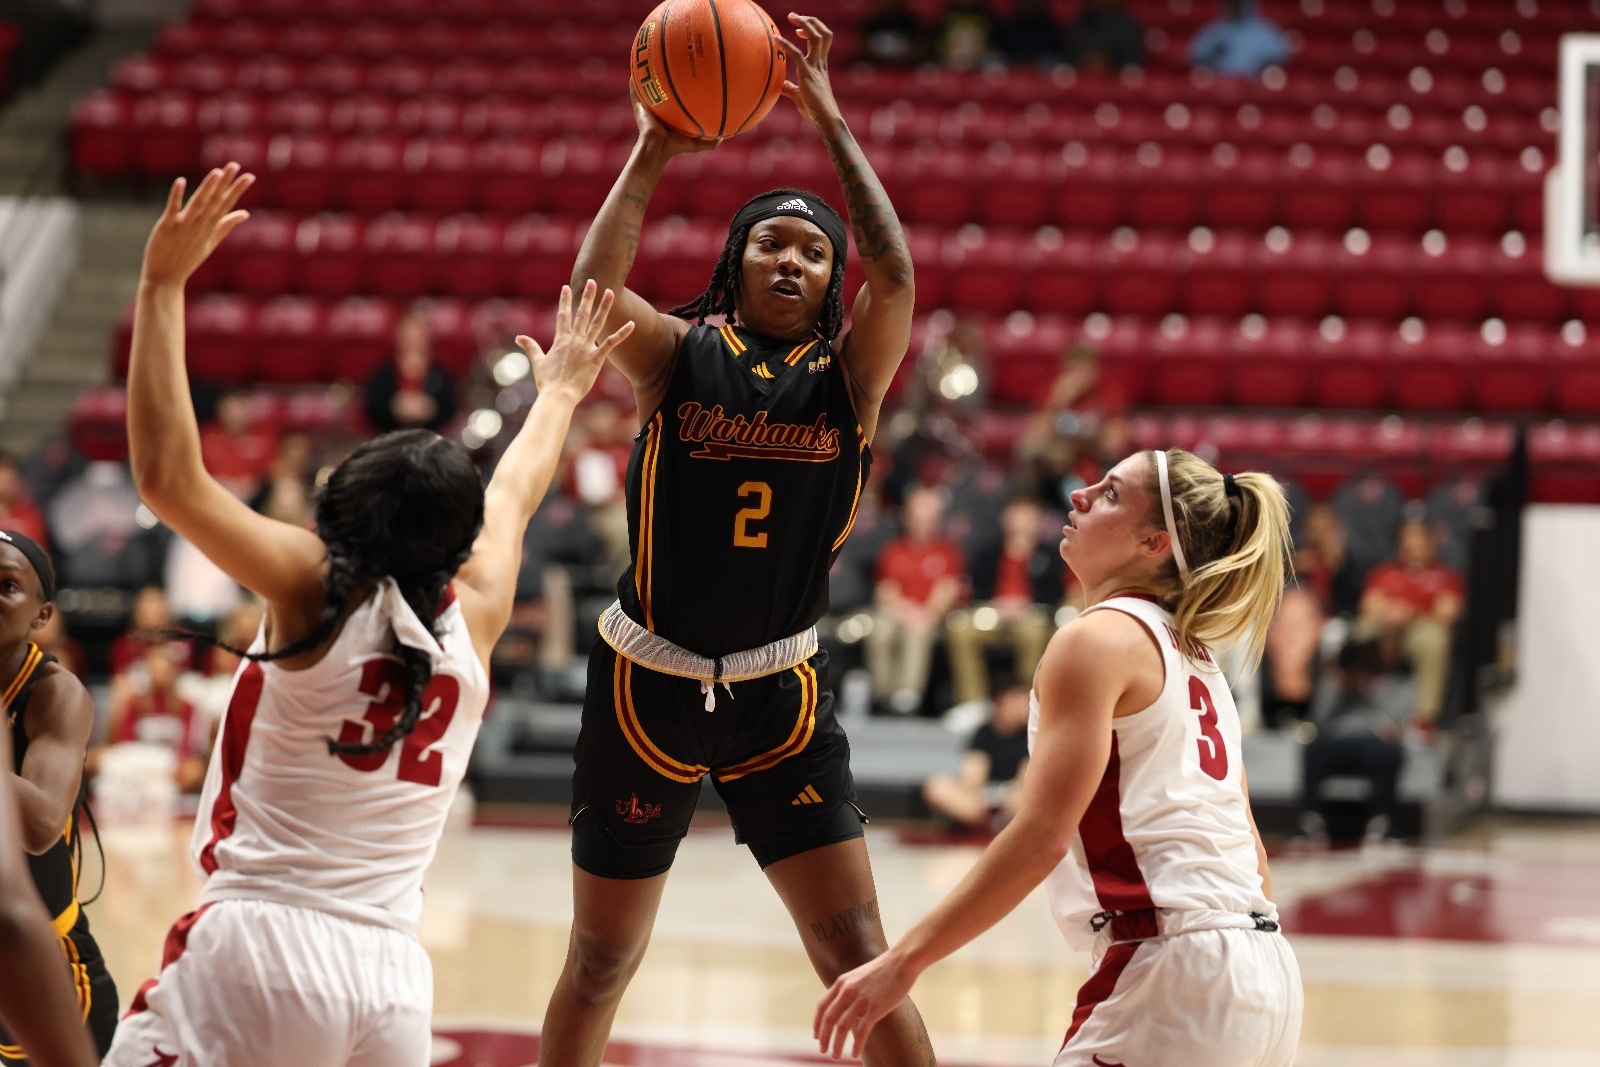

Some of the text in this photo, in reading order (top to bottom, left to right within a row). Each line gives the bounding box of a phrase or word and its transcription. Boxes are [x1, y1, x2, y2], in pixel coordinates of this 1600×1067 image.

[776, 203, 814, 216] adidas
[677, 401, 840, 451] Warhawks
[733, 480, 773, 548] 2
[336, 657, 460, 788] 32
[1187, 674, 1229, 781] 3
